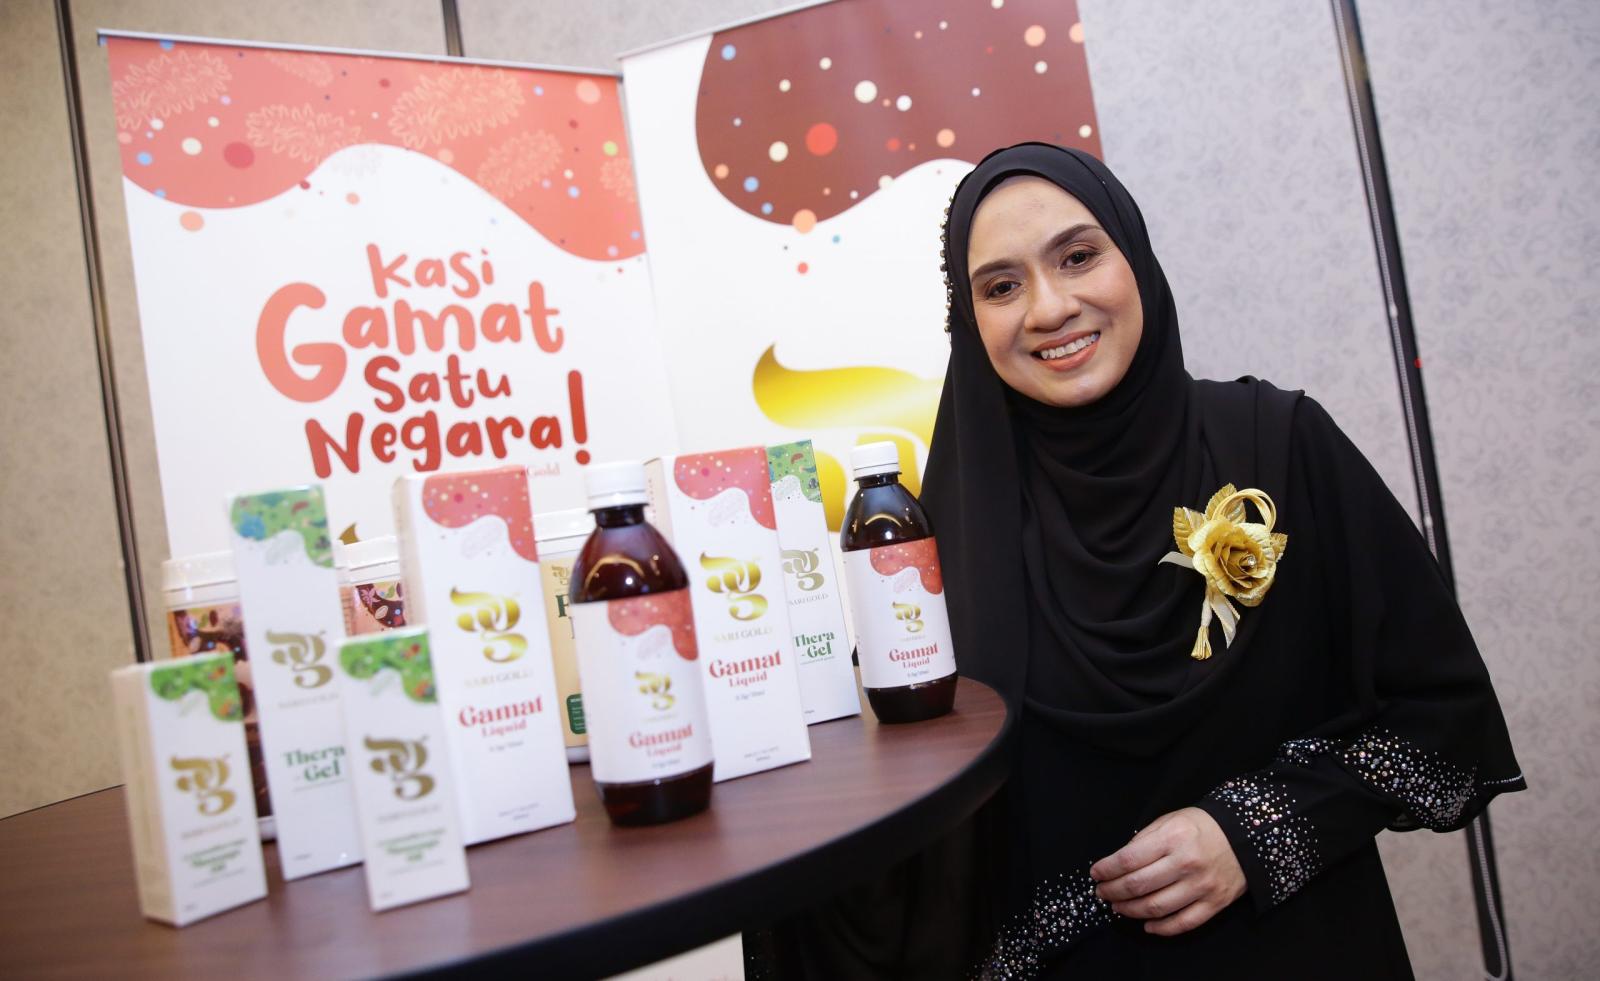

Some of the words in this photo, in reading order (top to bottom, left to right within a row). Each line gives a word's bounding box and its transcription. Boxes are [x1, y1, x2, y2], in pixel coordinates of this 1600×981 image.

[256, 281, 564, 403] Gamat
[364, 354, 511, 412] Satu
[305, 370, 591, 479] Negara!
[794, 631, 835, 647] Thera
[708, 648, 782, 679] Gamat
[889, 642, 939, 662] Gamat
[902, 657, 930, 670] Liquid
[729, 670, 768, 688] Liquid
[458, 693, 543, 728] Gamat
[481, 718, 528, 738] Liquid
[628, 722, 694, 749] Gamat
[283, 744, 346, 767] Thera
